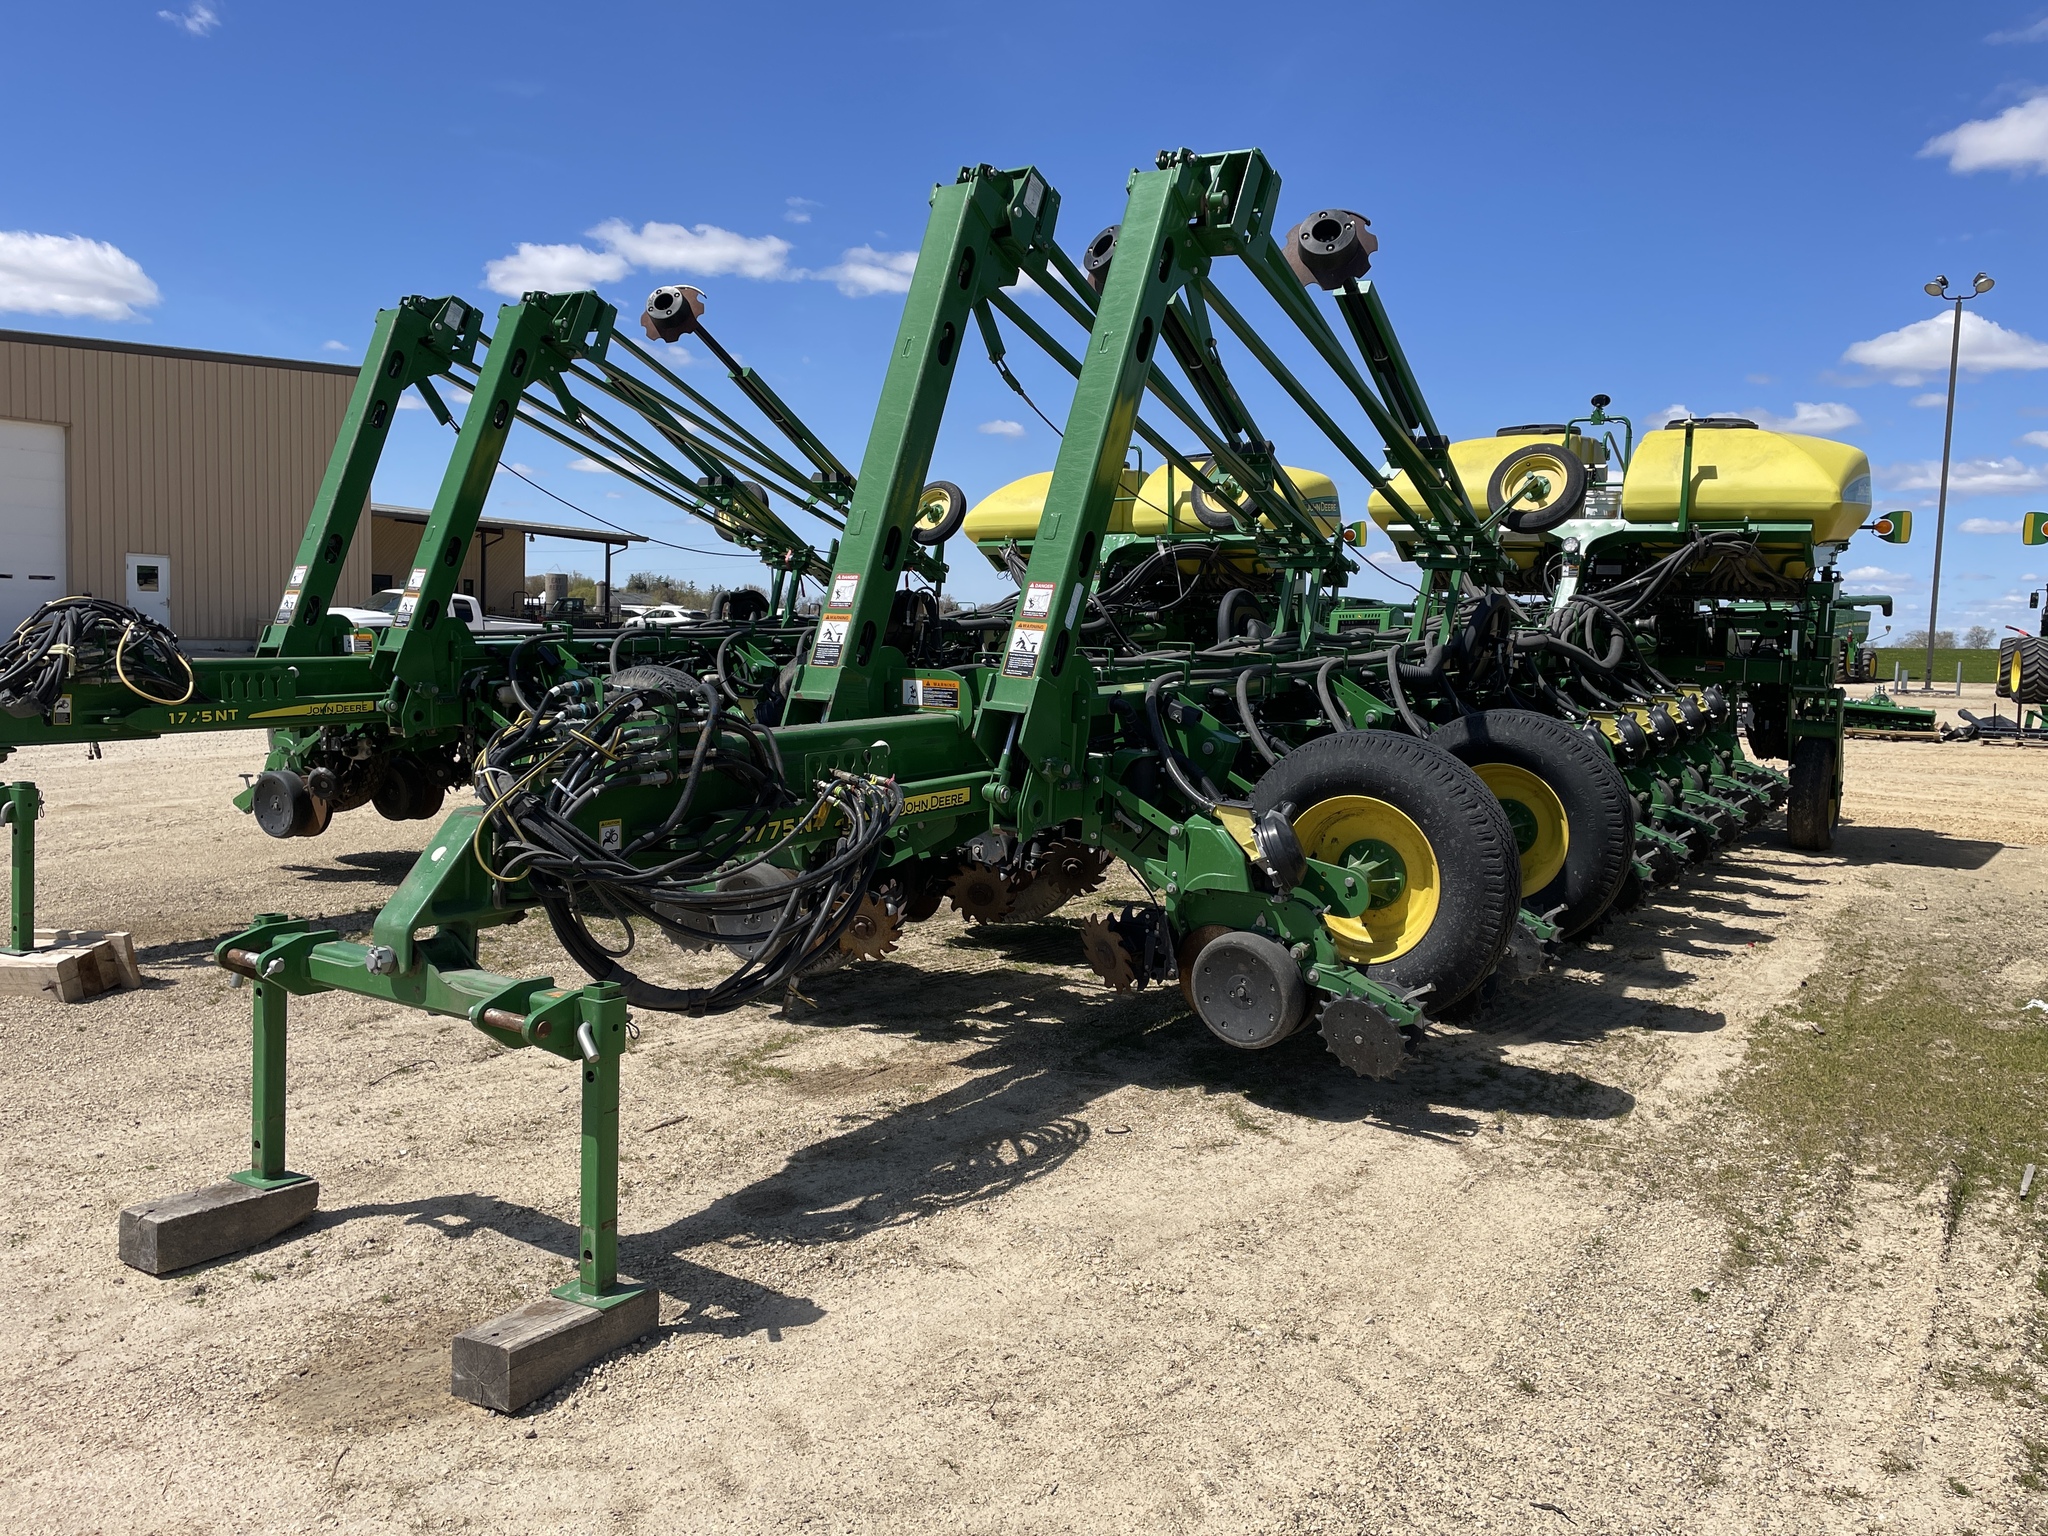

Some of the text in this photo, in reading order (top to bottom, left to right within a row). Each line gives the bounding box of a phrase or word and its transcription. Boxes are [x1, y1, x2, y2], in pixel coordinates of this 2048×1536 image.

[1321, 502, 1336, 511] DEERE
[306, 704, 368, 715] JOHN DEERE
[900, 798, 928, 814] JOHN
[931, 793, 964, 808] DEERE
